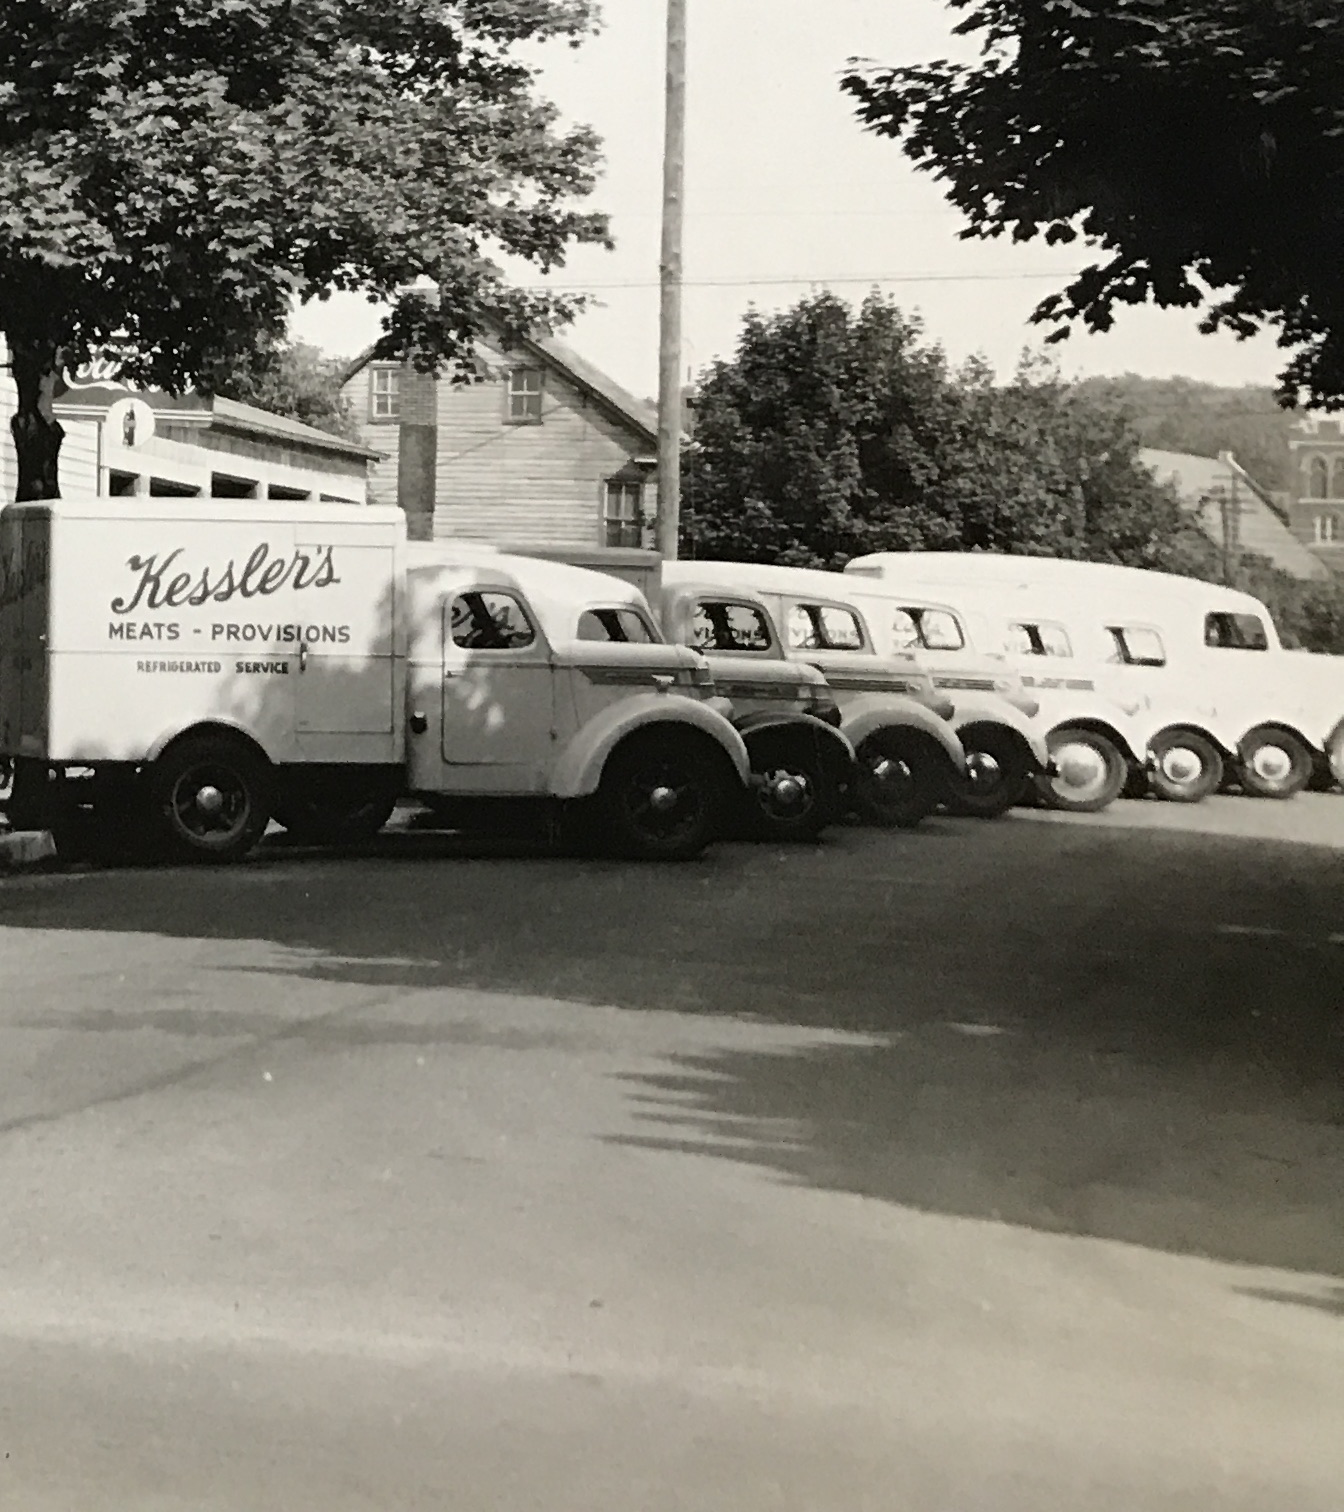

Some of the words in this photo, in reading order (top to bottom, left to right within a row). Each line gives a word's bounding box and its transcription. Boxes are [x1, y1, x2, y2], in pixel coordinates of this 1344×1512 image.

[111, 542, 341, 614] Kessler's
[108, 622, 180, 640] MEATS
[211, 623, 351, 643] PROVISIONS
[136, 660, 222, 674] REFRIGERATED
[235, 661, 289, 675] SERVICE
